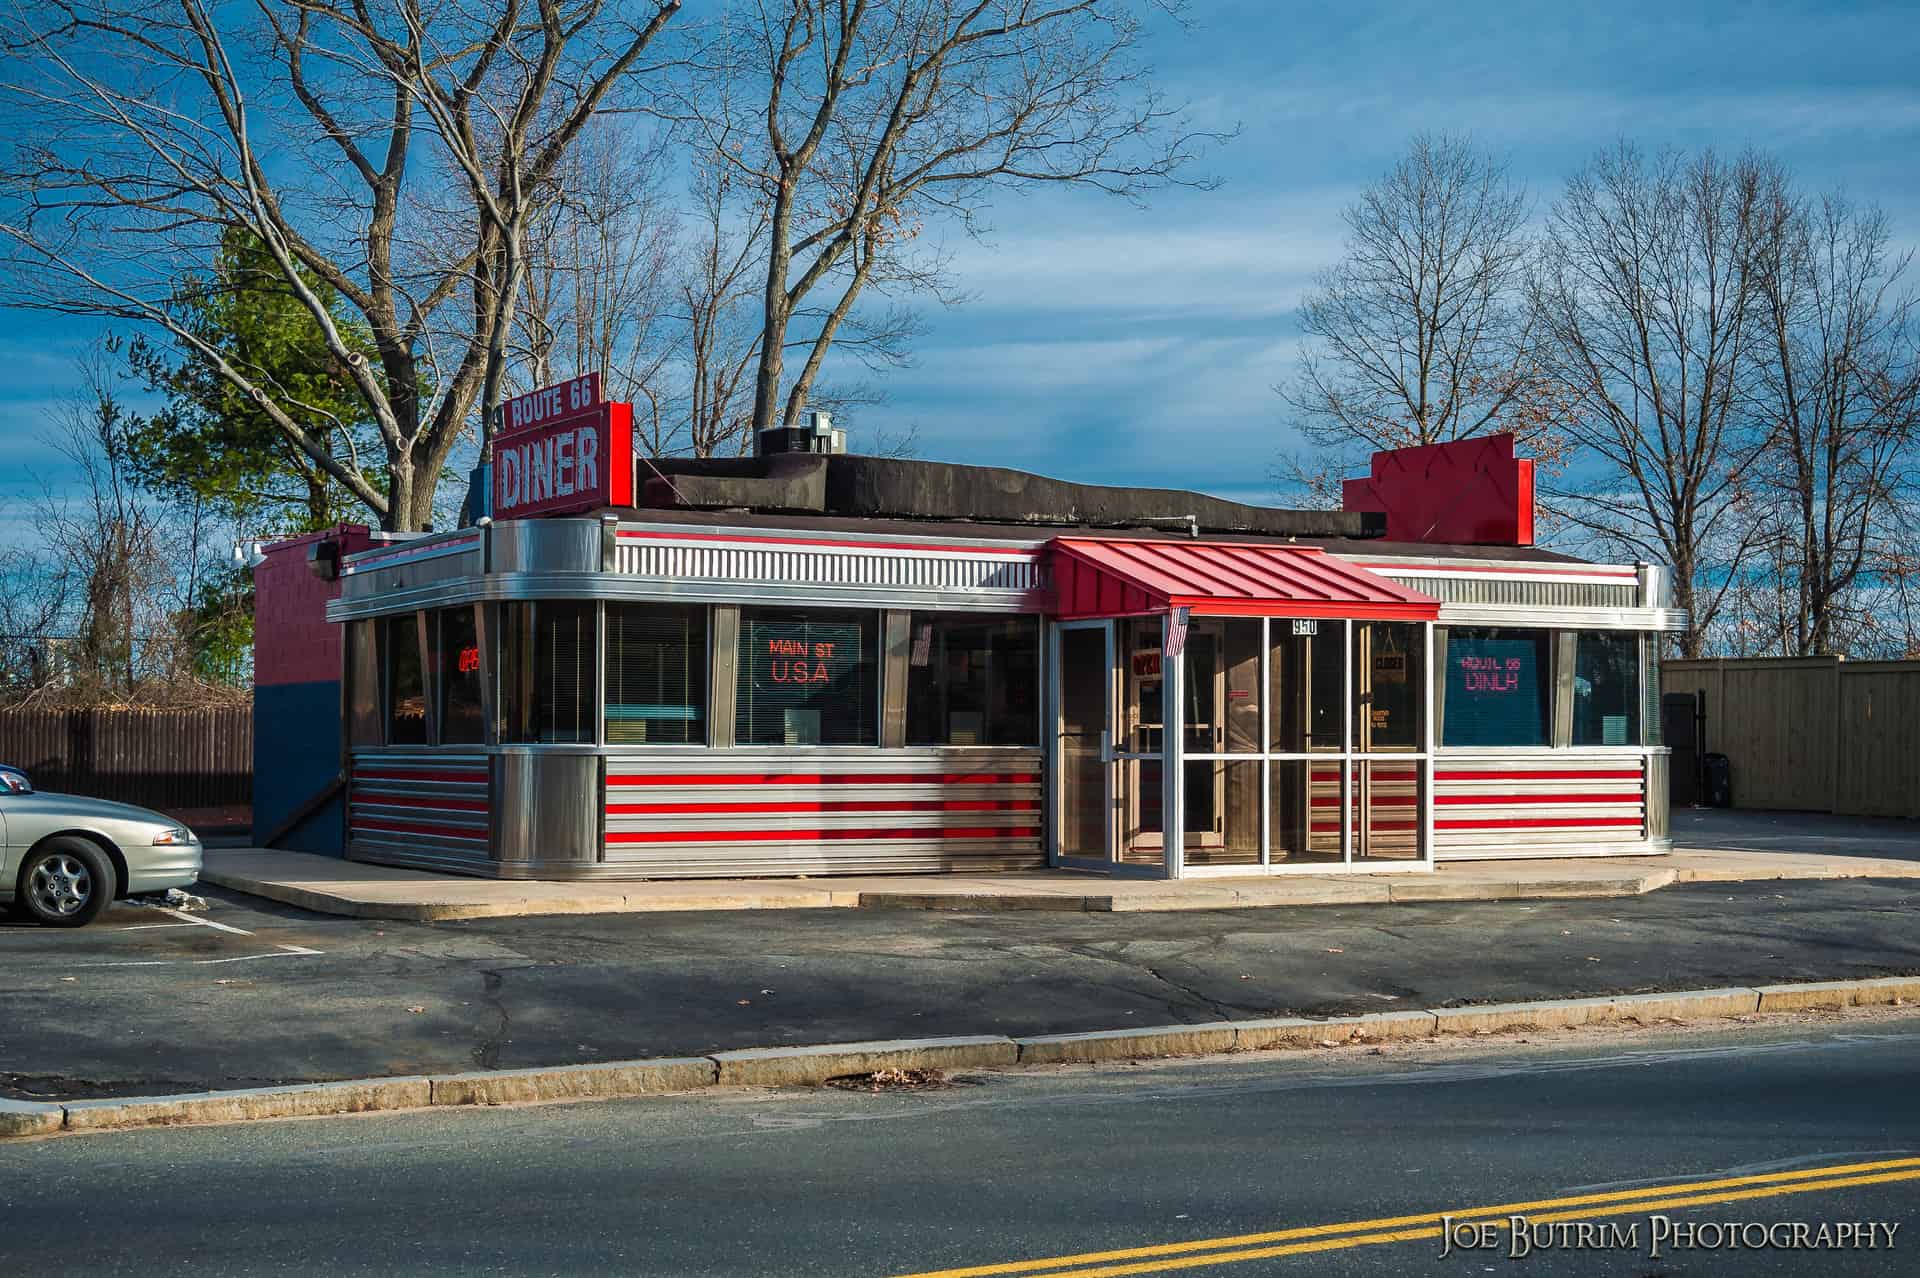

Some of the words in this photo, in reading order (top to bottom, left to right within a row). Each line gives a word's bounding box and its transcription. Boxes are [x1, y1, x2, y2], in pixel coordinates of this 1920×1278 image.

[512, 386, 562, 428] ROUTE
[570, 378, 592, 411] 66
[500, 426, 598, 509] DINER
[1294, 619, 1315, 634] 950
[769, 639, 808, 657] MAIN
[815, 642, 834, 658] ST
